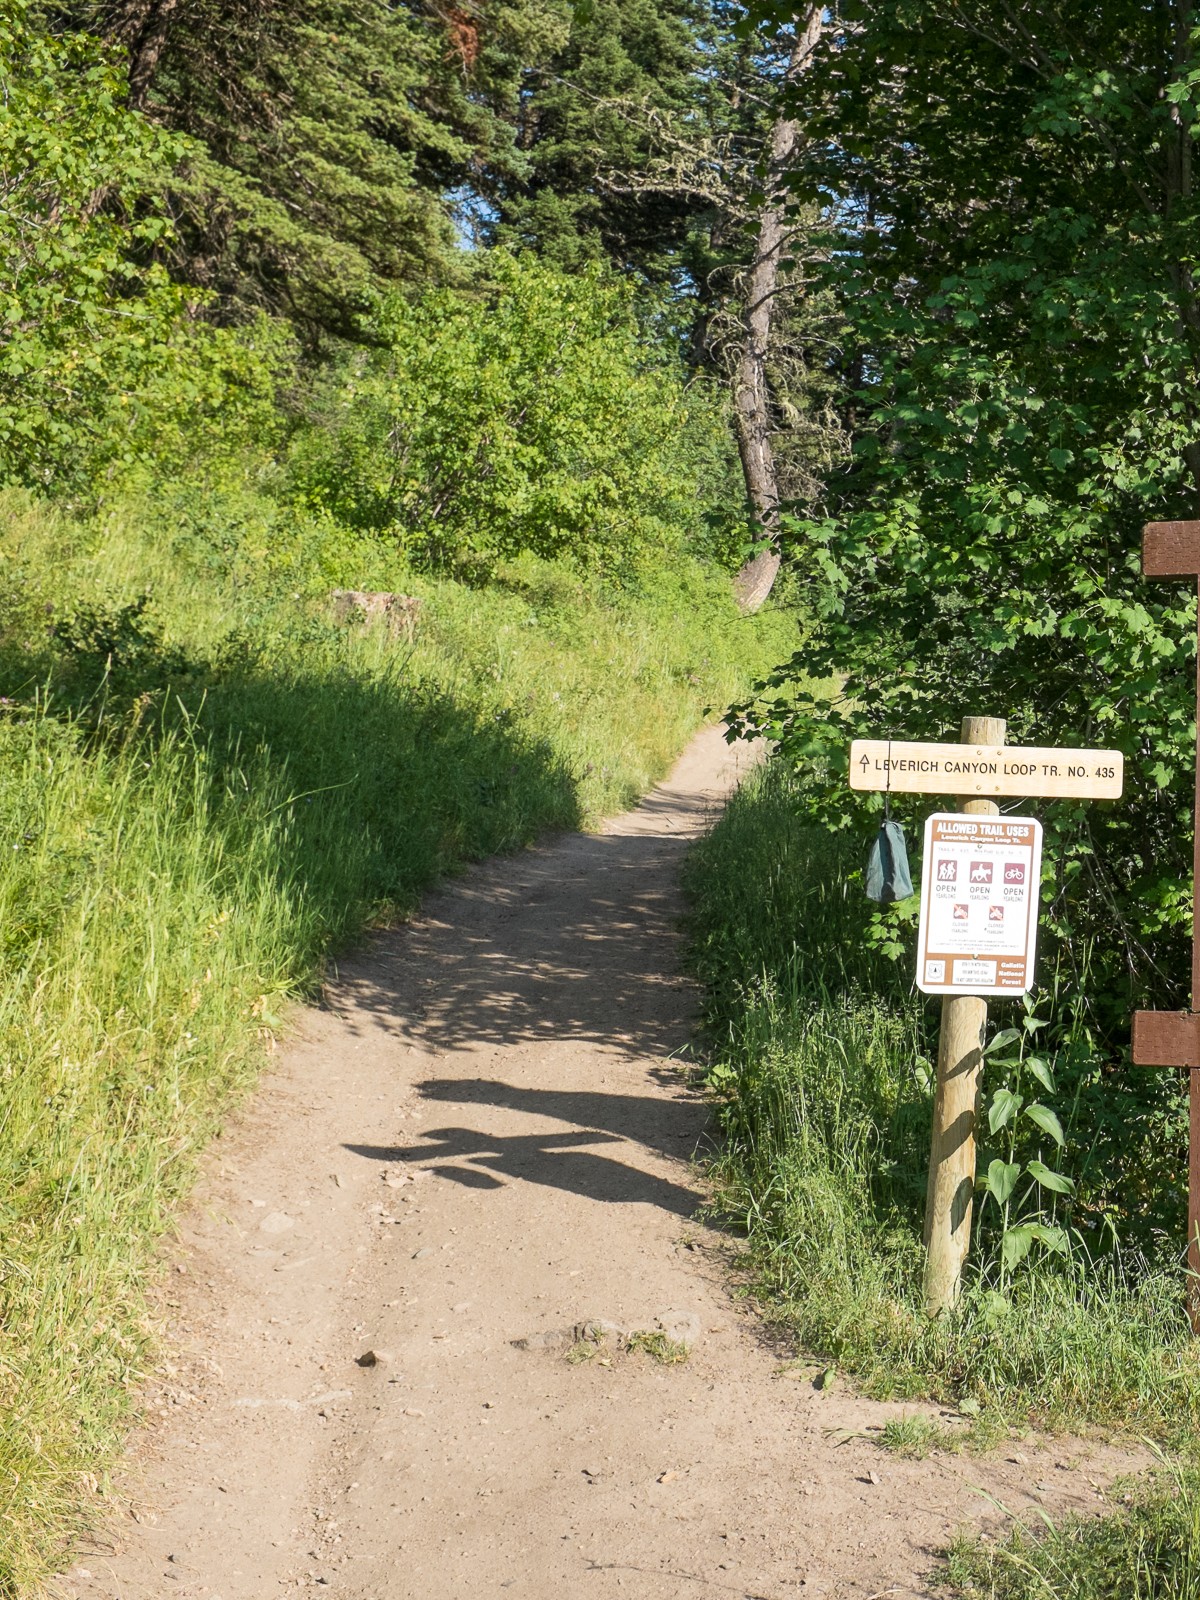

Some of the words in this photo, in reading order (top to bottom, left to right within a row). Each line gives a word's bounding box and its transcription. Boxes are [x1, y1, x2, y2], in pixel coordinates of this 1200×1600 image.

[875, 759, 938, 772] LEVERICH
[945, 762, 997, 774] CANYON
[1004, 764, 1036, 775] LOOP
[1042, 766, 1061, 776] TR.
[1068, 767, 1088, 777] NO.
[1095, 767, 1114, 778] 435
[937, 823, 977, 834] ALLOWED
[980, 825, 1004, 835] TRAIL
[1007, 826, 1028, 837] USES
